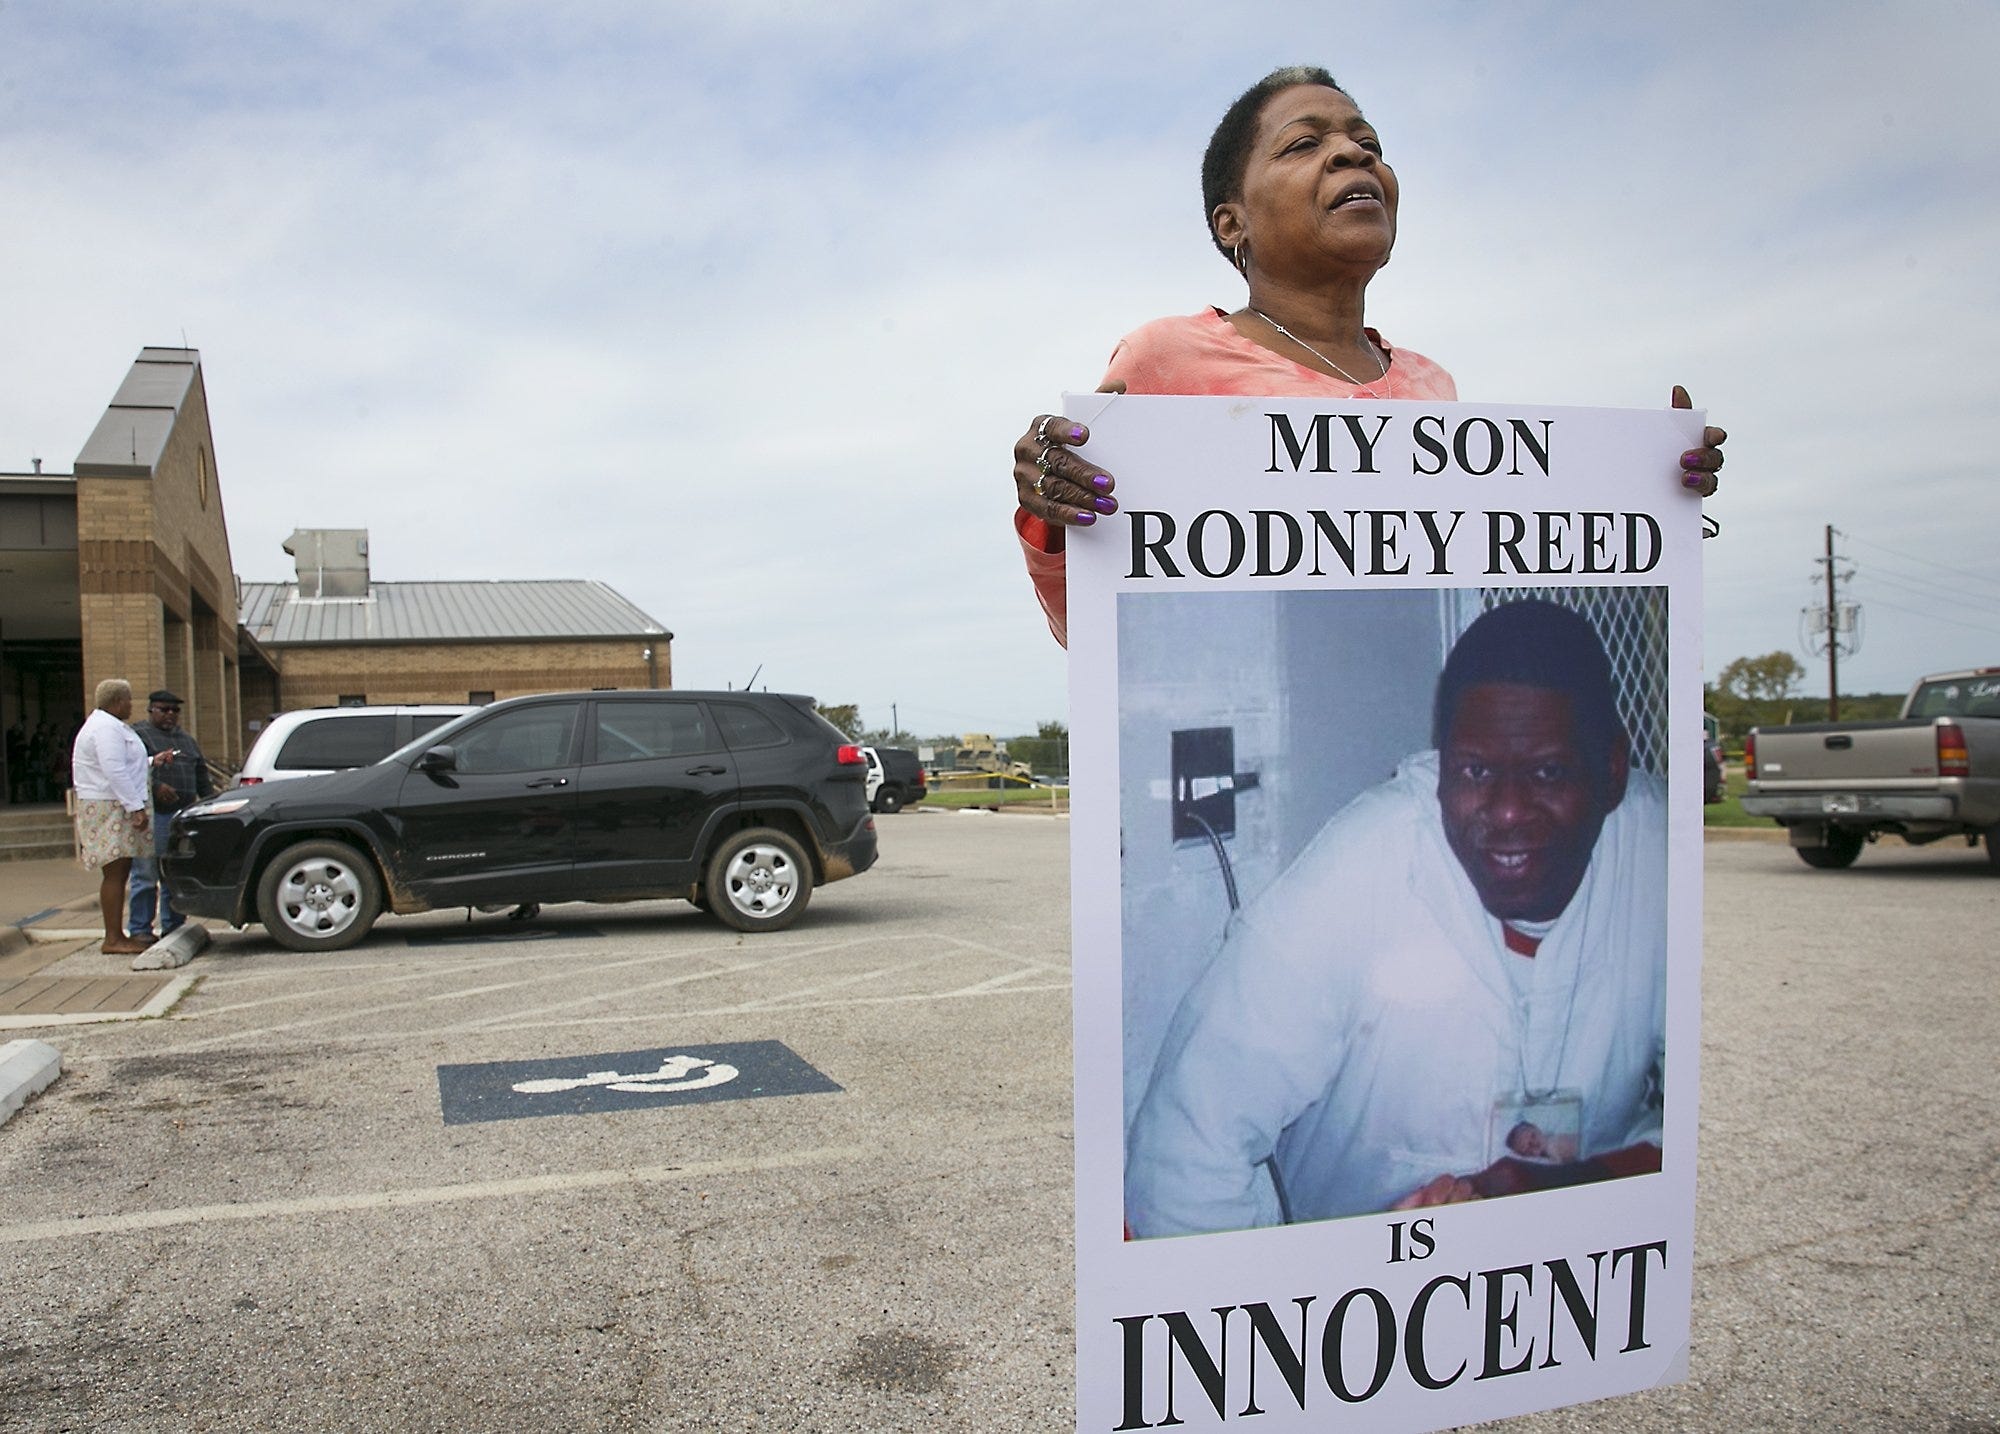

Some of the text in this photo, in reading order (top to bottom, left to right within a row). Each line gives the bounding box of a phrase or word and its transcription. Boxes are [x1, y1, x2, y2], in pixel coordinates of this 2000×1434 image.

[1264, 414, 1554, 476] MY SON
[1124, 510, 1662, 578] RODNEY REED
[1387, 1218, 1435, 1263] IS
[1113, 1240, 1667, 1431] INNOCENT
